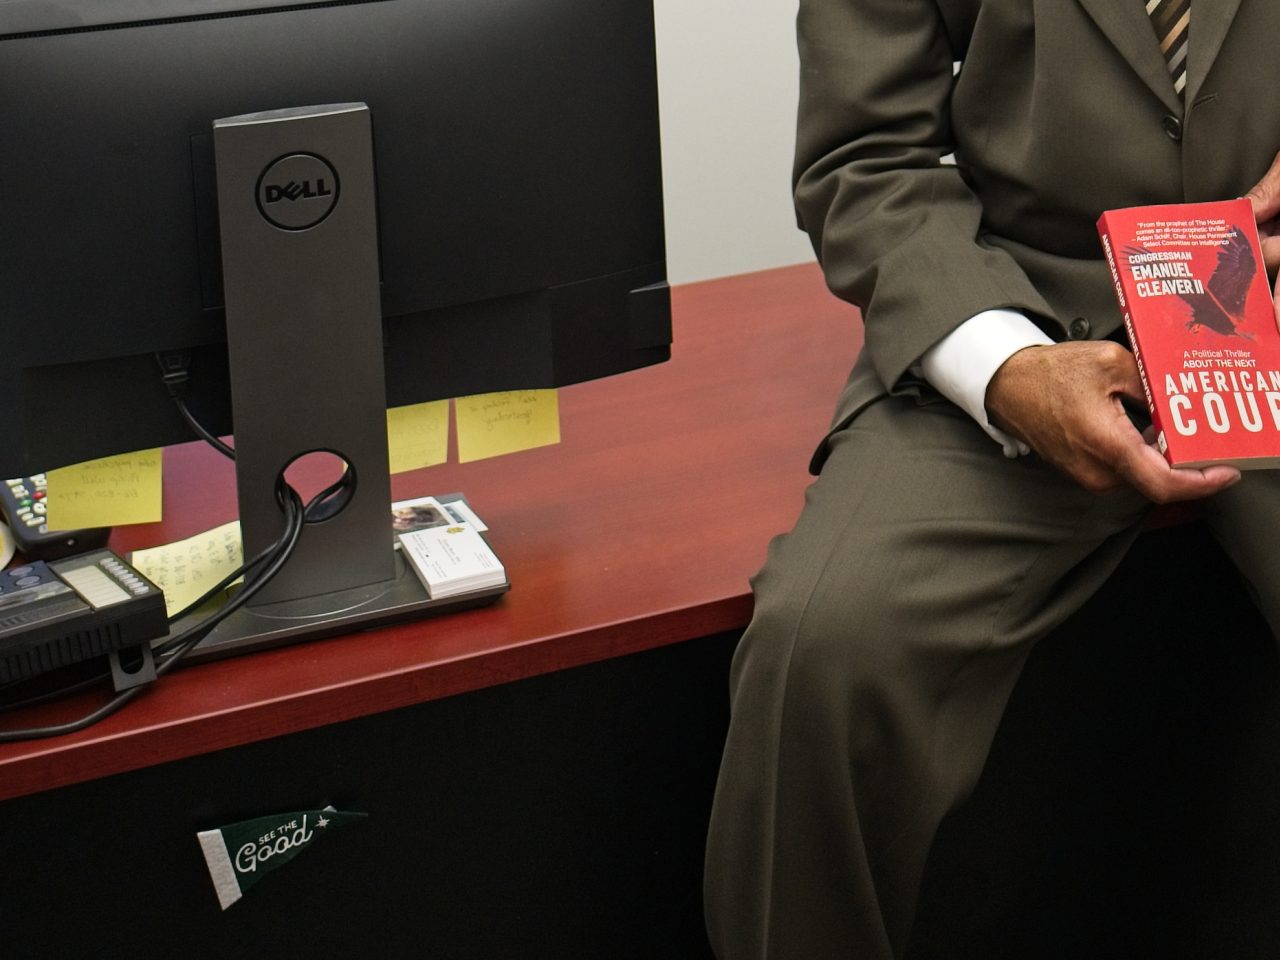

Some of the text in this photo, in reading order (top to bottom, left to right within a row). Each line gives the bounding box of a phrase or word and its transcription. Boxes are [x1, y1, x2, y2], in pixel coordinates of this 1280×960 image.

[265, 178, 331, 203] DELL
[1166, 220, 1187, 229] prophet
[1207, 231, 1237, 239] Permanent
[1142, 240, 1161, 248] Select
[1129, 251, 1193, 264] CONGRESSMAN
[1131, 262, 1194, 281] EMANUEL
[1136, 279, 1205, 298] CLEAVER II
[1102, 234, 1118, 282] AMERICAN
[1114, 281, 1126, 308] COUP
[1123, 312, 1140, 360] EMANUEL
[1136, 358, 1152, 403] CLEAVER
[1184, 349, 1251, 358] A Political Thriller
[1183, 359, 1256, 369] ABOUT THE NEXT
[258, 820, 298, 845] SEE THE
[235, 814, 314, 873] Good
